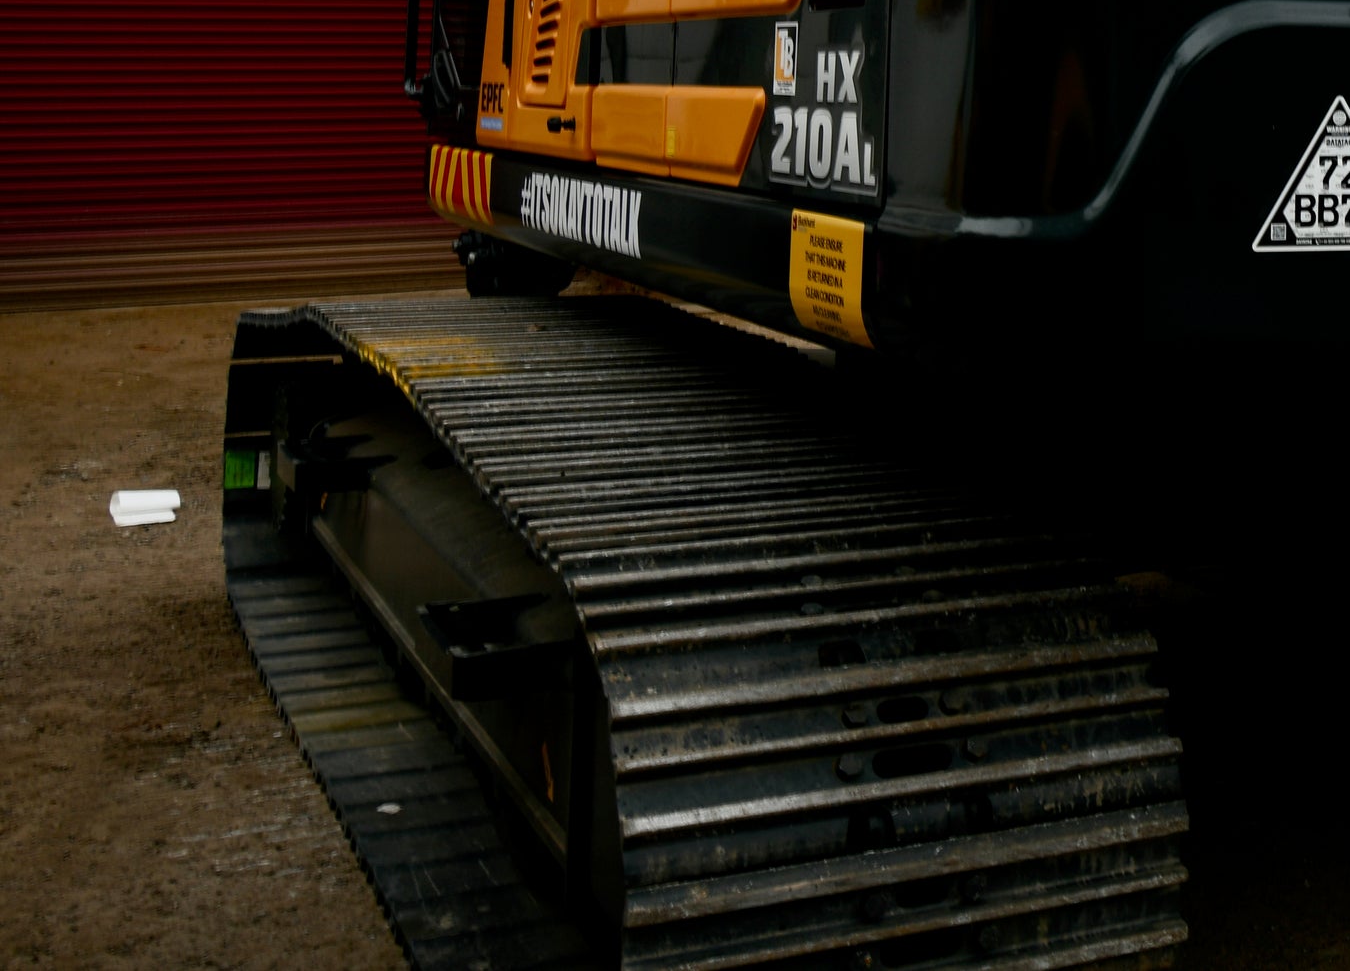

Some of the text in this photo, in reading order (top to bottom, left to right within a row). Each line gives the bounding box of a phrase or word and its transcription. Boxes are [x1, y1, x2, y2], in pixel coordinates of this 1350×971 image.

[481, 83, 505, 113] EPFC
[816, 49, 861, 104] HX
[771, 106, 876, 186] 210AL
[521, 171, 642, 260] #ITSOKAYTOTALK
